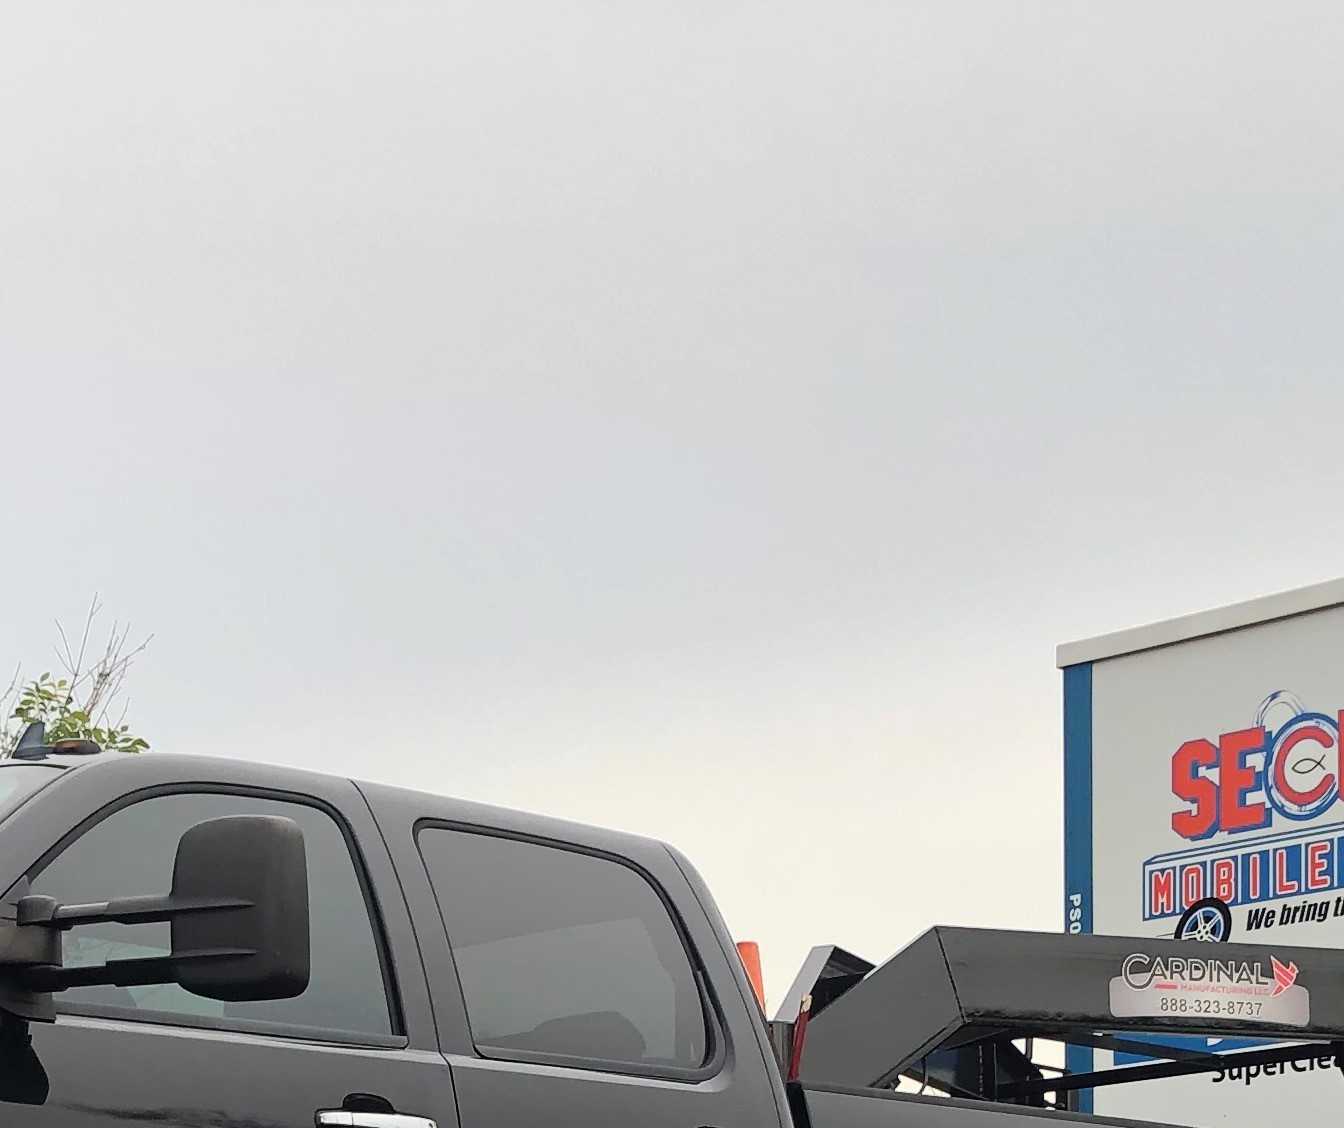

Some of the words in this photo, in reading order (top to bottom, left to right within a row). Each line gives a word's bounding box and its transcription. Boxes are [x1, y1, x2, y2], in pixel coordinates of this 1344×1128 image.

[1151, 841, 1331, 915] MOBILE
[1246, 907, 1276, 931] We
[1278, 900, 1330, 926] bring
[1122, 953, 1269, 991] CARDINAL
[1180, 983, 1253, 995] MANUFACTURING
[1254, 988, 1269, 996] LLC
[1160, 997, 1264, 1017] 888-323-8737
